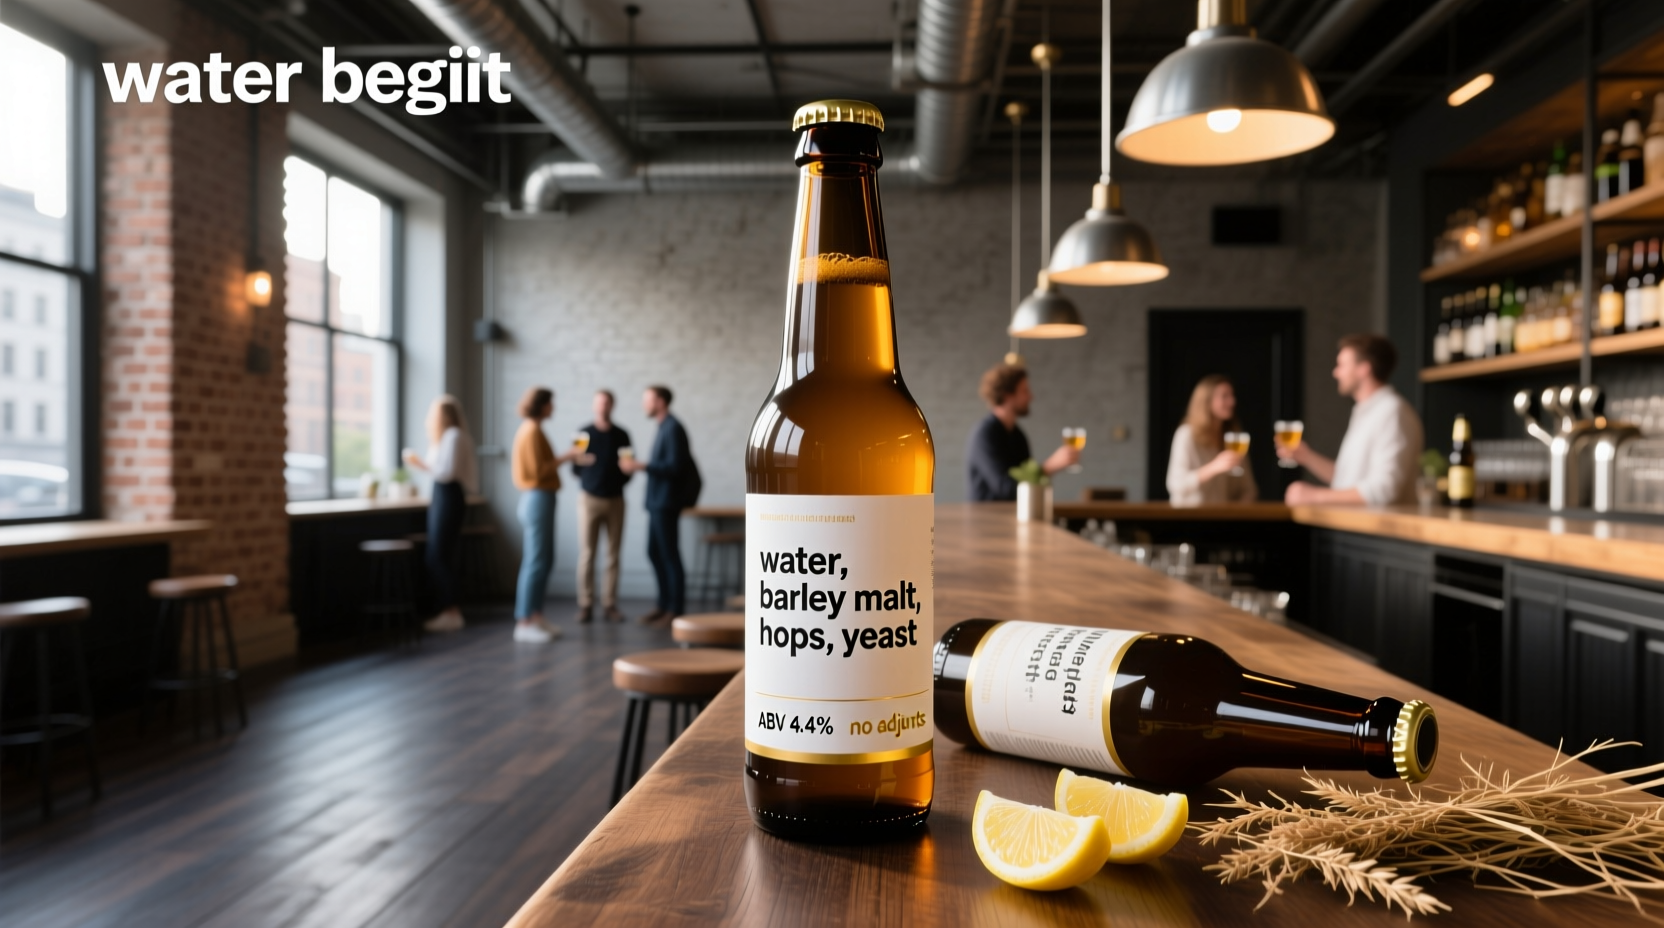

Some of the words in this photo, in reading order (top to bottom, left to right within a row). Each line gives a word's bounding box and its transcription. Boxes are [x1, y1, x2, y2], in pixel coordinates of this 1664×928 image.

[760, 547, 848, 580] water,
[760, 580, 847, 620] barley
[854, 580, 921, 614] malt,
[760, 617, 834, 657] hops,
[842, 619, 917, 657] yeast
[758, 711, 786, 732] ABV
[790, 716, 834, 735] 4.4%
[850, 720, 873, 735] no
